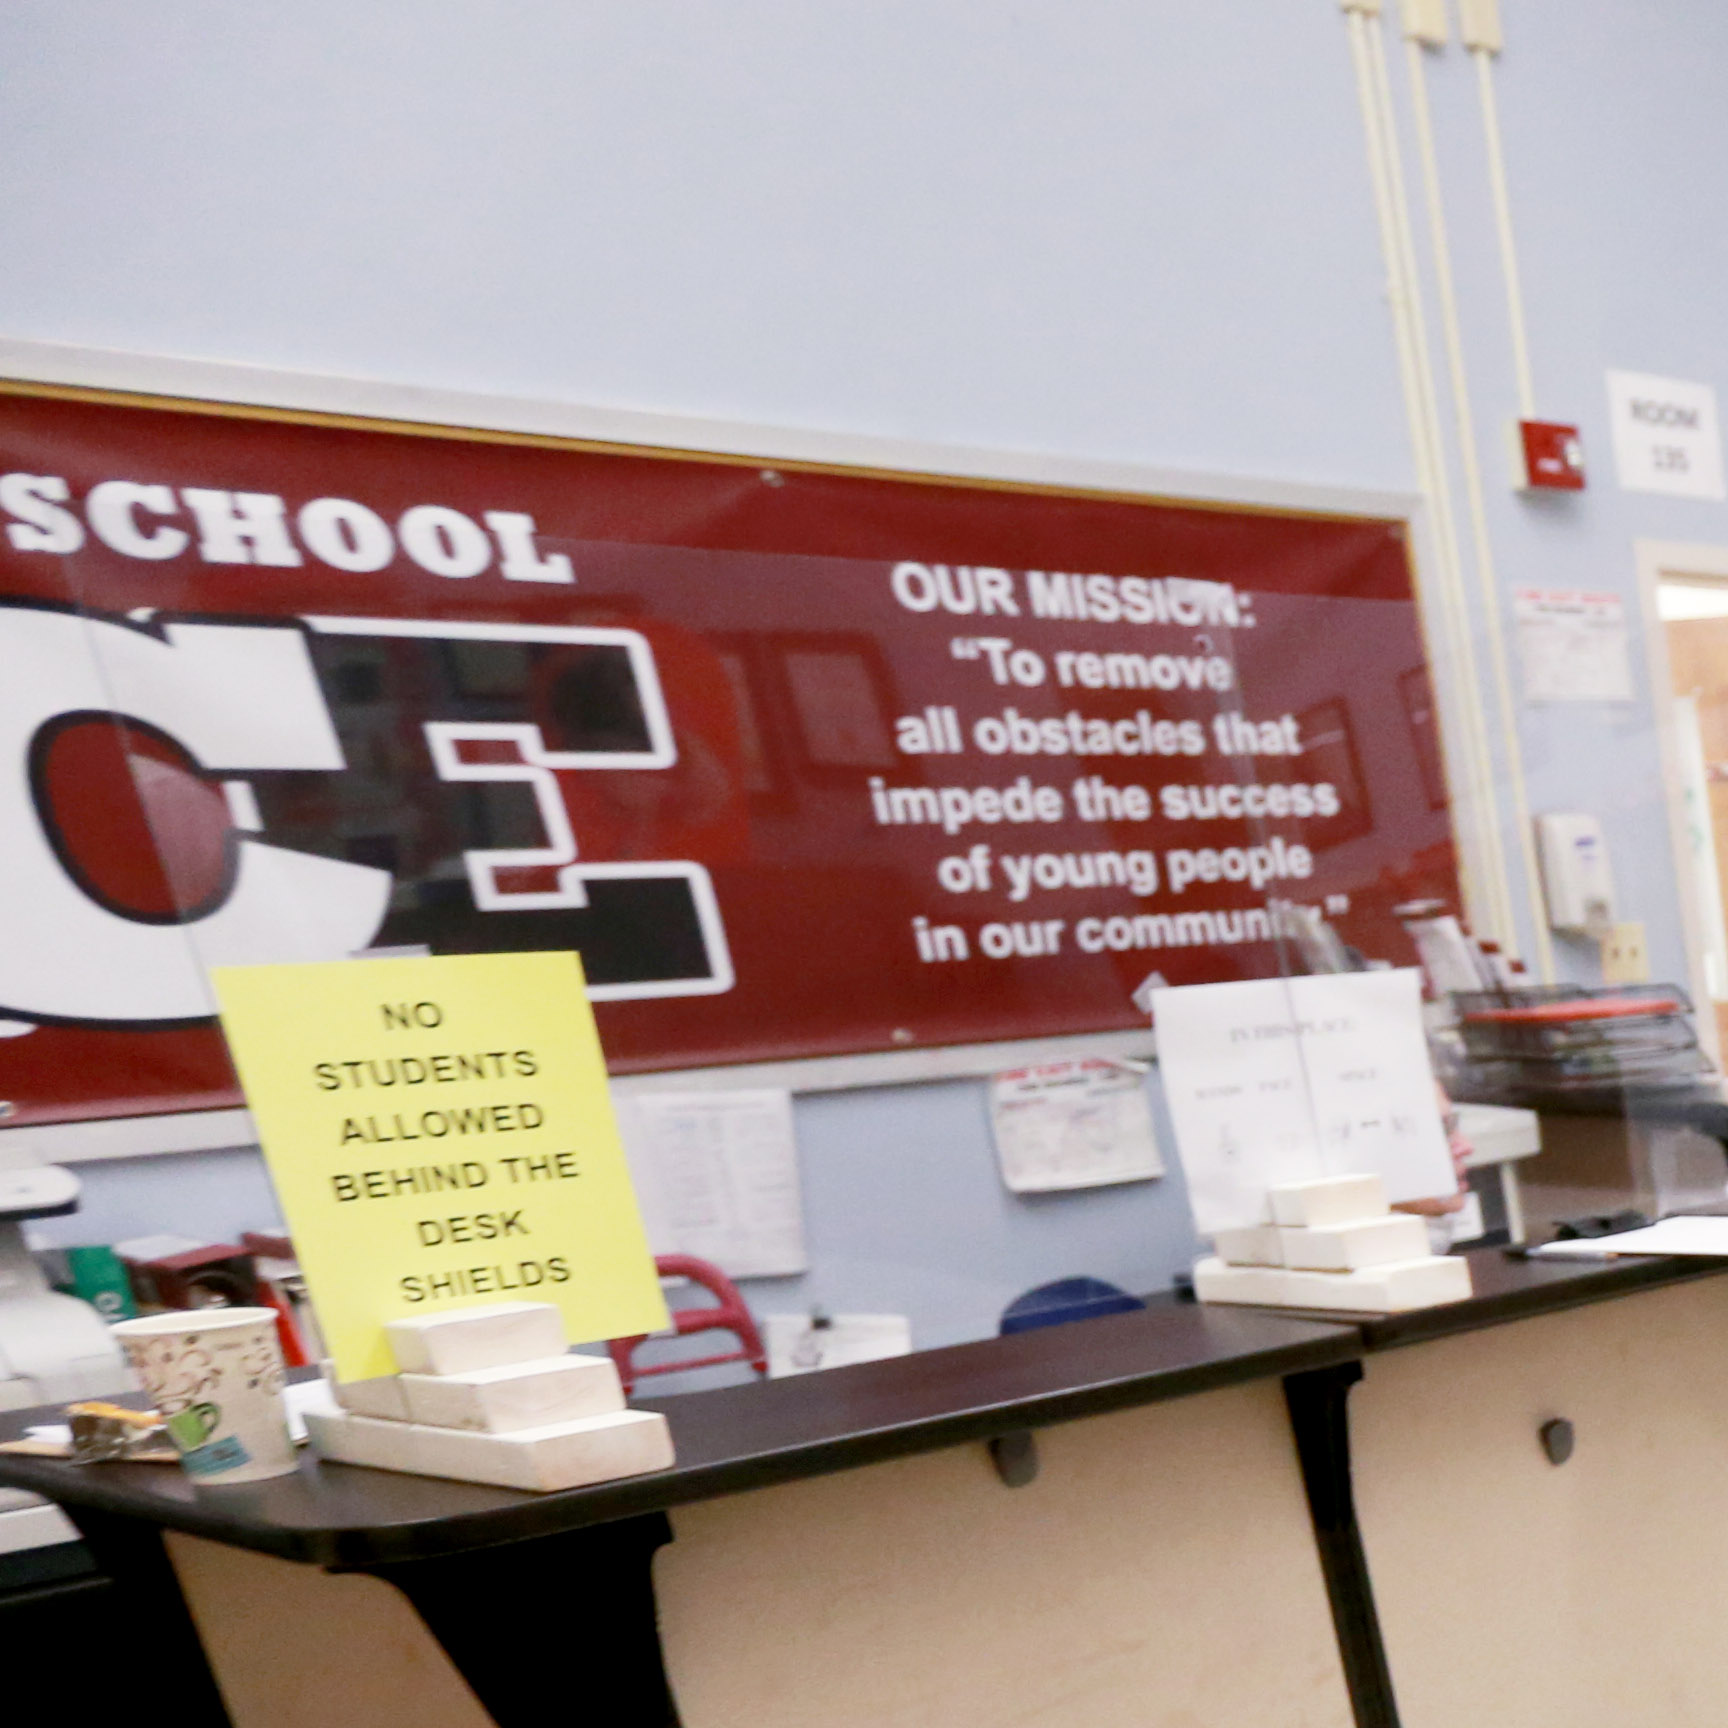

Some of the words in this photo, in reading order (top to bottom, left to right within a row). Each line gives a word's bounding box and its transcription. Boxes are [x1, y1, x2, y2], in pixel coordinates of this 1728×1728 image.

[1630, 399, 1700, 430] ROOM
[0, 472, 577, 585] SCHOOL
[890, 561, 1020, 617] OUR
[1026, 570, 1256, 628] MISSION:
[1055, 650, 1233, 692] remove
[896, 705, 963, 755] all
[973, 706, 1207, 757] obstacles
[1212, 711, 1303, 755] that
[868, 776, 1064, 836] impede
[1072, 775, 1153, 823] the
[1159, 780, 1342, 819] success
[937, 844, 992, 893] of
[1001, 848, 1160, 902] young
[1166, 836, 1314, 893] people
[912, 915, 969, 963] in
[979, 919, 1066, 960] our
[379, 1001, 444, 1031] NO
[313, 1050, 539, 1091] STUDENTS
[340, 1102, 545, 1146] ALLOWED
[331, 1160, 489, 1202] BEHIND
[499, 1151, 581, 1184] THE
[416, 1209, 532, 1248] DESK
[398, 1256, 573, 1303] SHIELDS
